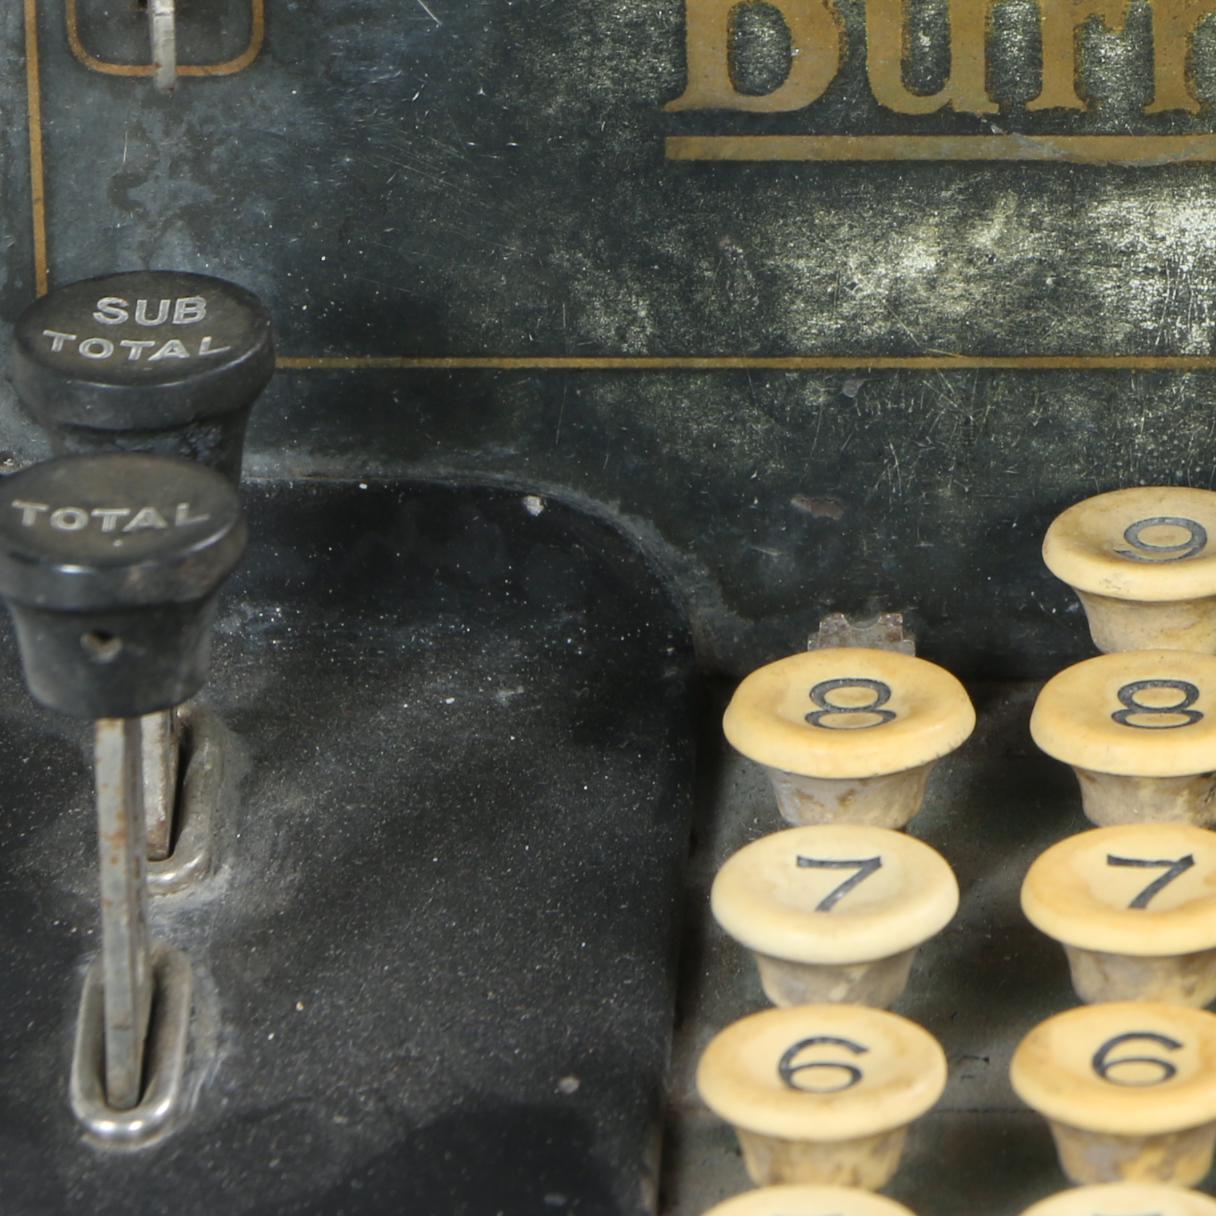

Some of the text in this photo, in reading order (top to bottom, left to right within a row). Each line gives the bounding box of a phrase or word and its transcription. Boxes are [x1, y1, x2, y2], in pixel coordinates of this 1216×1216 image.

[92, 295, 208, 326] SUB
[43, 329, 231, 362] TOTAL
[11, 499, 210, 533] TOTAL
[1114, 516, 1208, 562] 9
[804, 678, 897, 729] 8
[1111, 679, 1204, 729] 8
[796, 855, 882, 913] 7
[1106, 853, 1195, 910] 7
[778, 1036, 869, 1094] 6
[1091, 1031, 1184, 1086] 6
